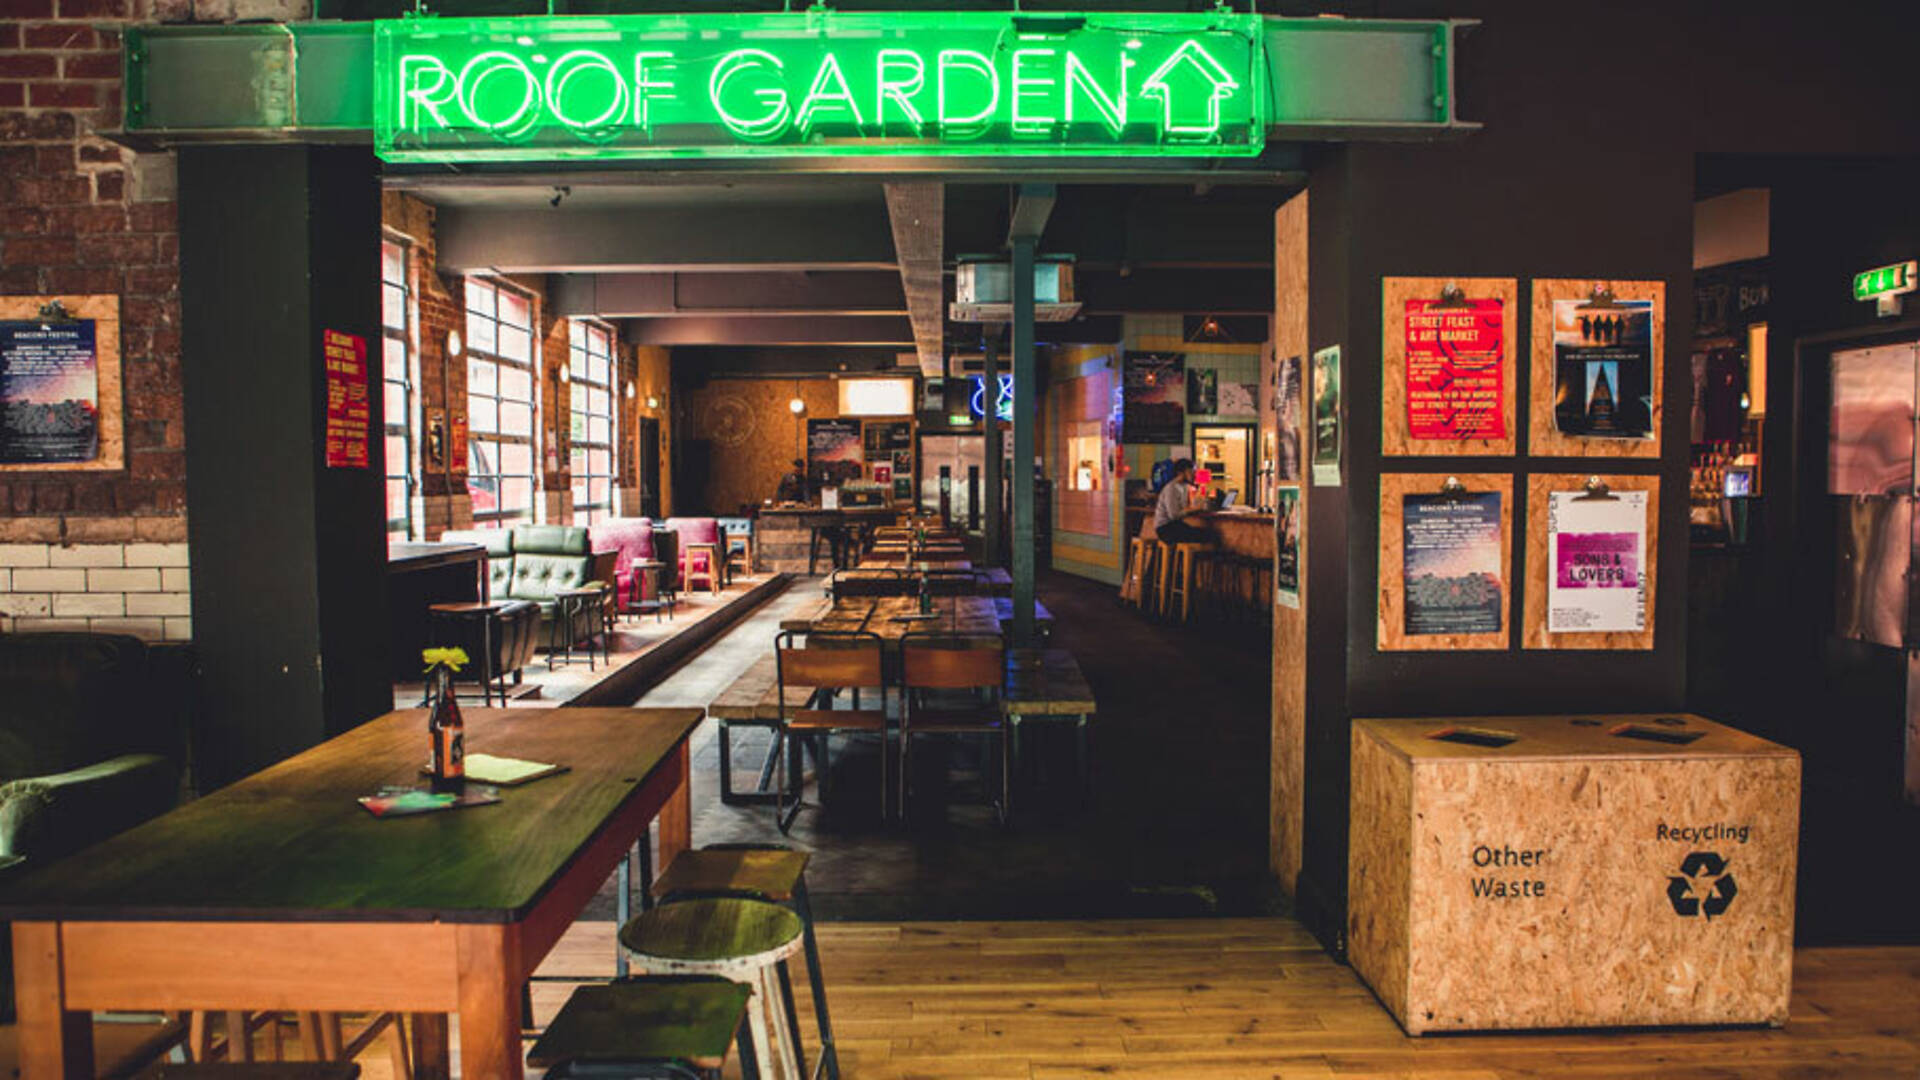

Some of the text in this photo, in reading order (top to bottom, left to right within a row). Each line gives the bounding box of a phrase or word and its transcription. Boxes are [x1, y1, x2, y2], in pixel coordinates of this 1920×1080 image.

[399, 48, 1128, 130] ROOF GARDEN
[1409, 316, 1476, 328] STREET FEAST
[1409, 330, 1479, 341] & ART MARKET
[1573, 553, 1622, 567] SONS &
[1569, 567, 1625, 582] LOVERS
[1656, 822, 1750, 844] Recycling
[1472, 845, 1544, 867] Other
[1471, 877, 1546, 898] Waste
